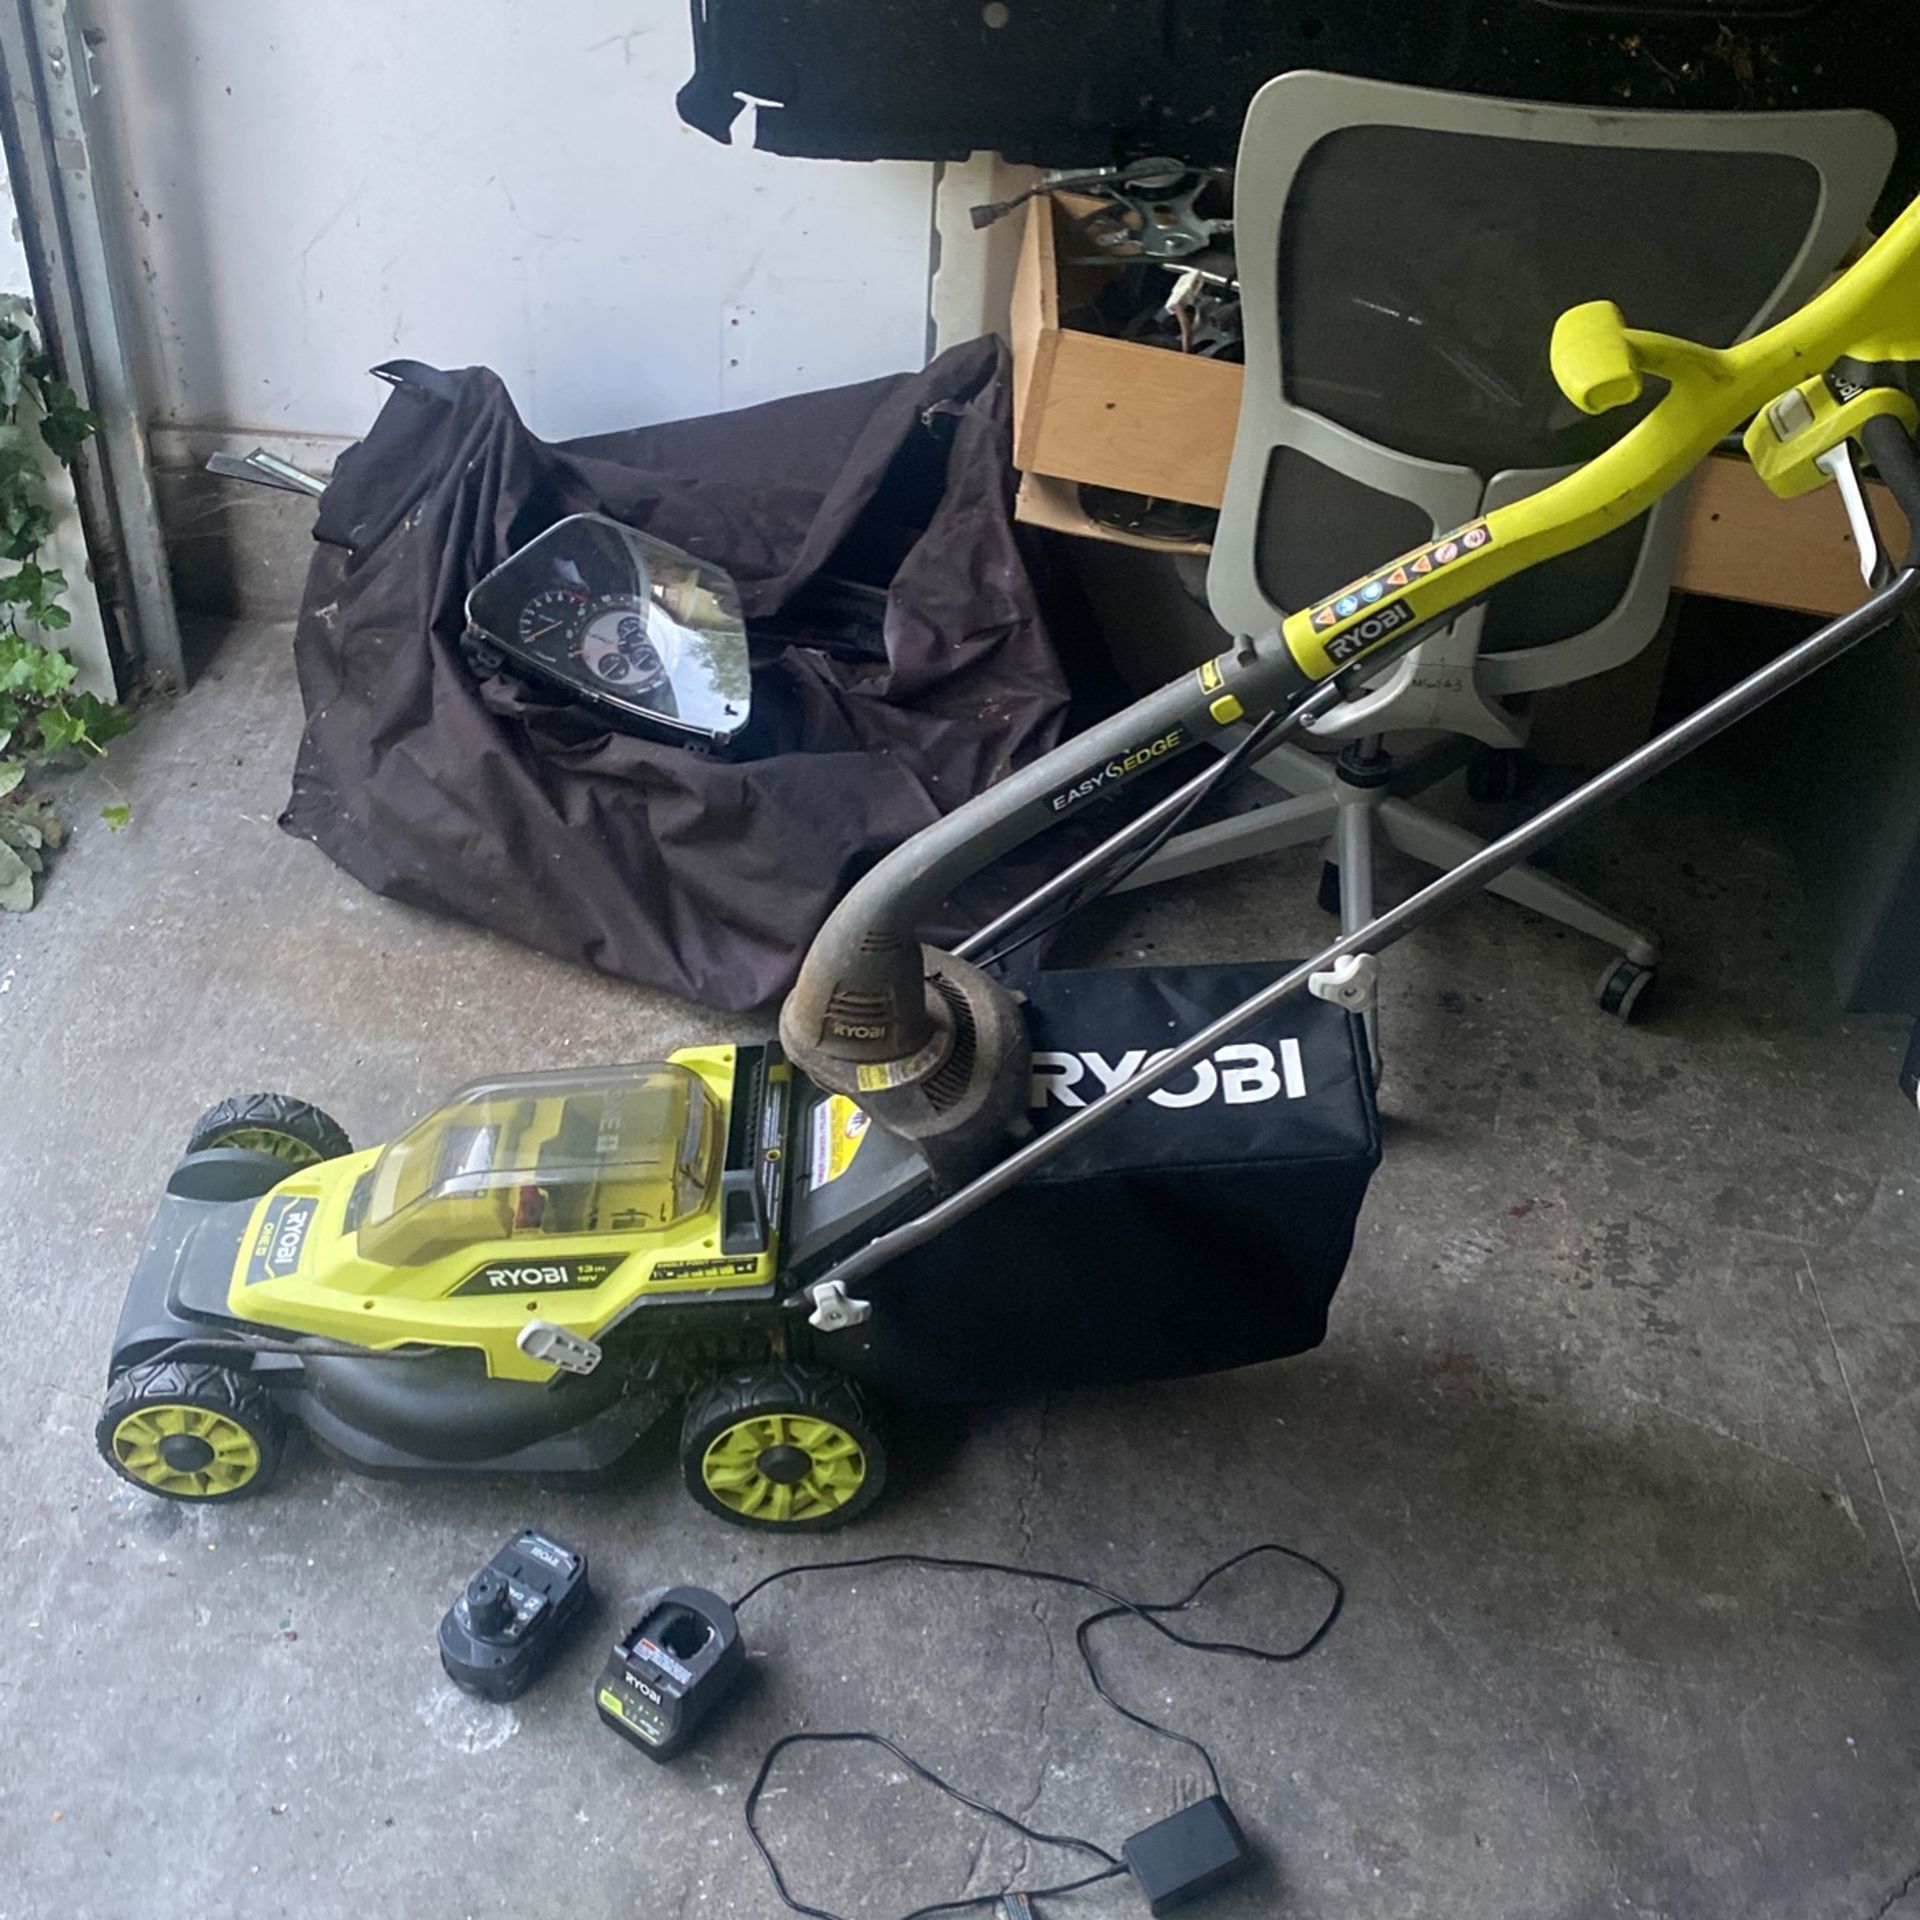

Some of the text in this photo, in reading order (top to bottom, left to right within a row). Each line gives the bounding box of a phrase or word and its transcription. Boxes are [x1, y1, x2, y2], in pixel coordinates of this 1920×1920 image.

[1327, 605, 1408, 659] RYOBI
[1052, 730, 1182, 812] EASY EDGE
[834, 1022, 886, 1039] RYOBI
[1030, 1037, 1307, 1109] RYOBI
[274, 1210, 309, 1264] RYOBI
[485, 1266, 570, 1288] RYOBI
[624, 1671, 661, 1705] RYOBI
